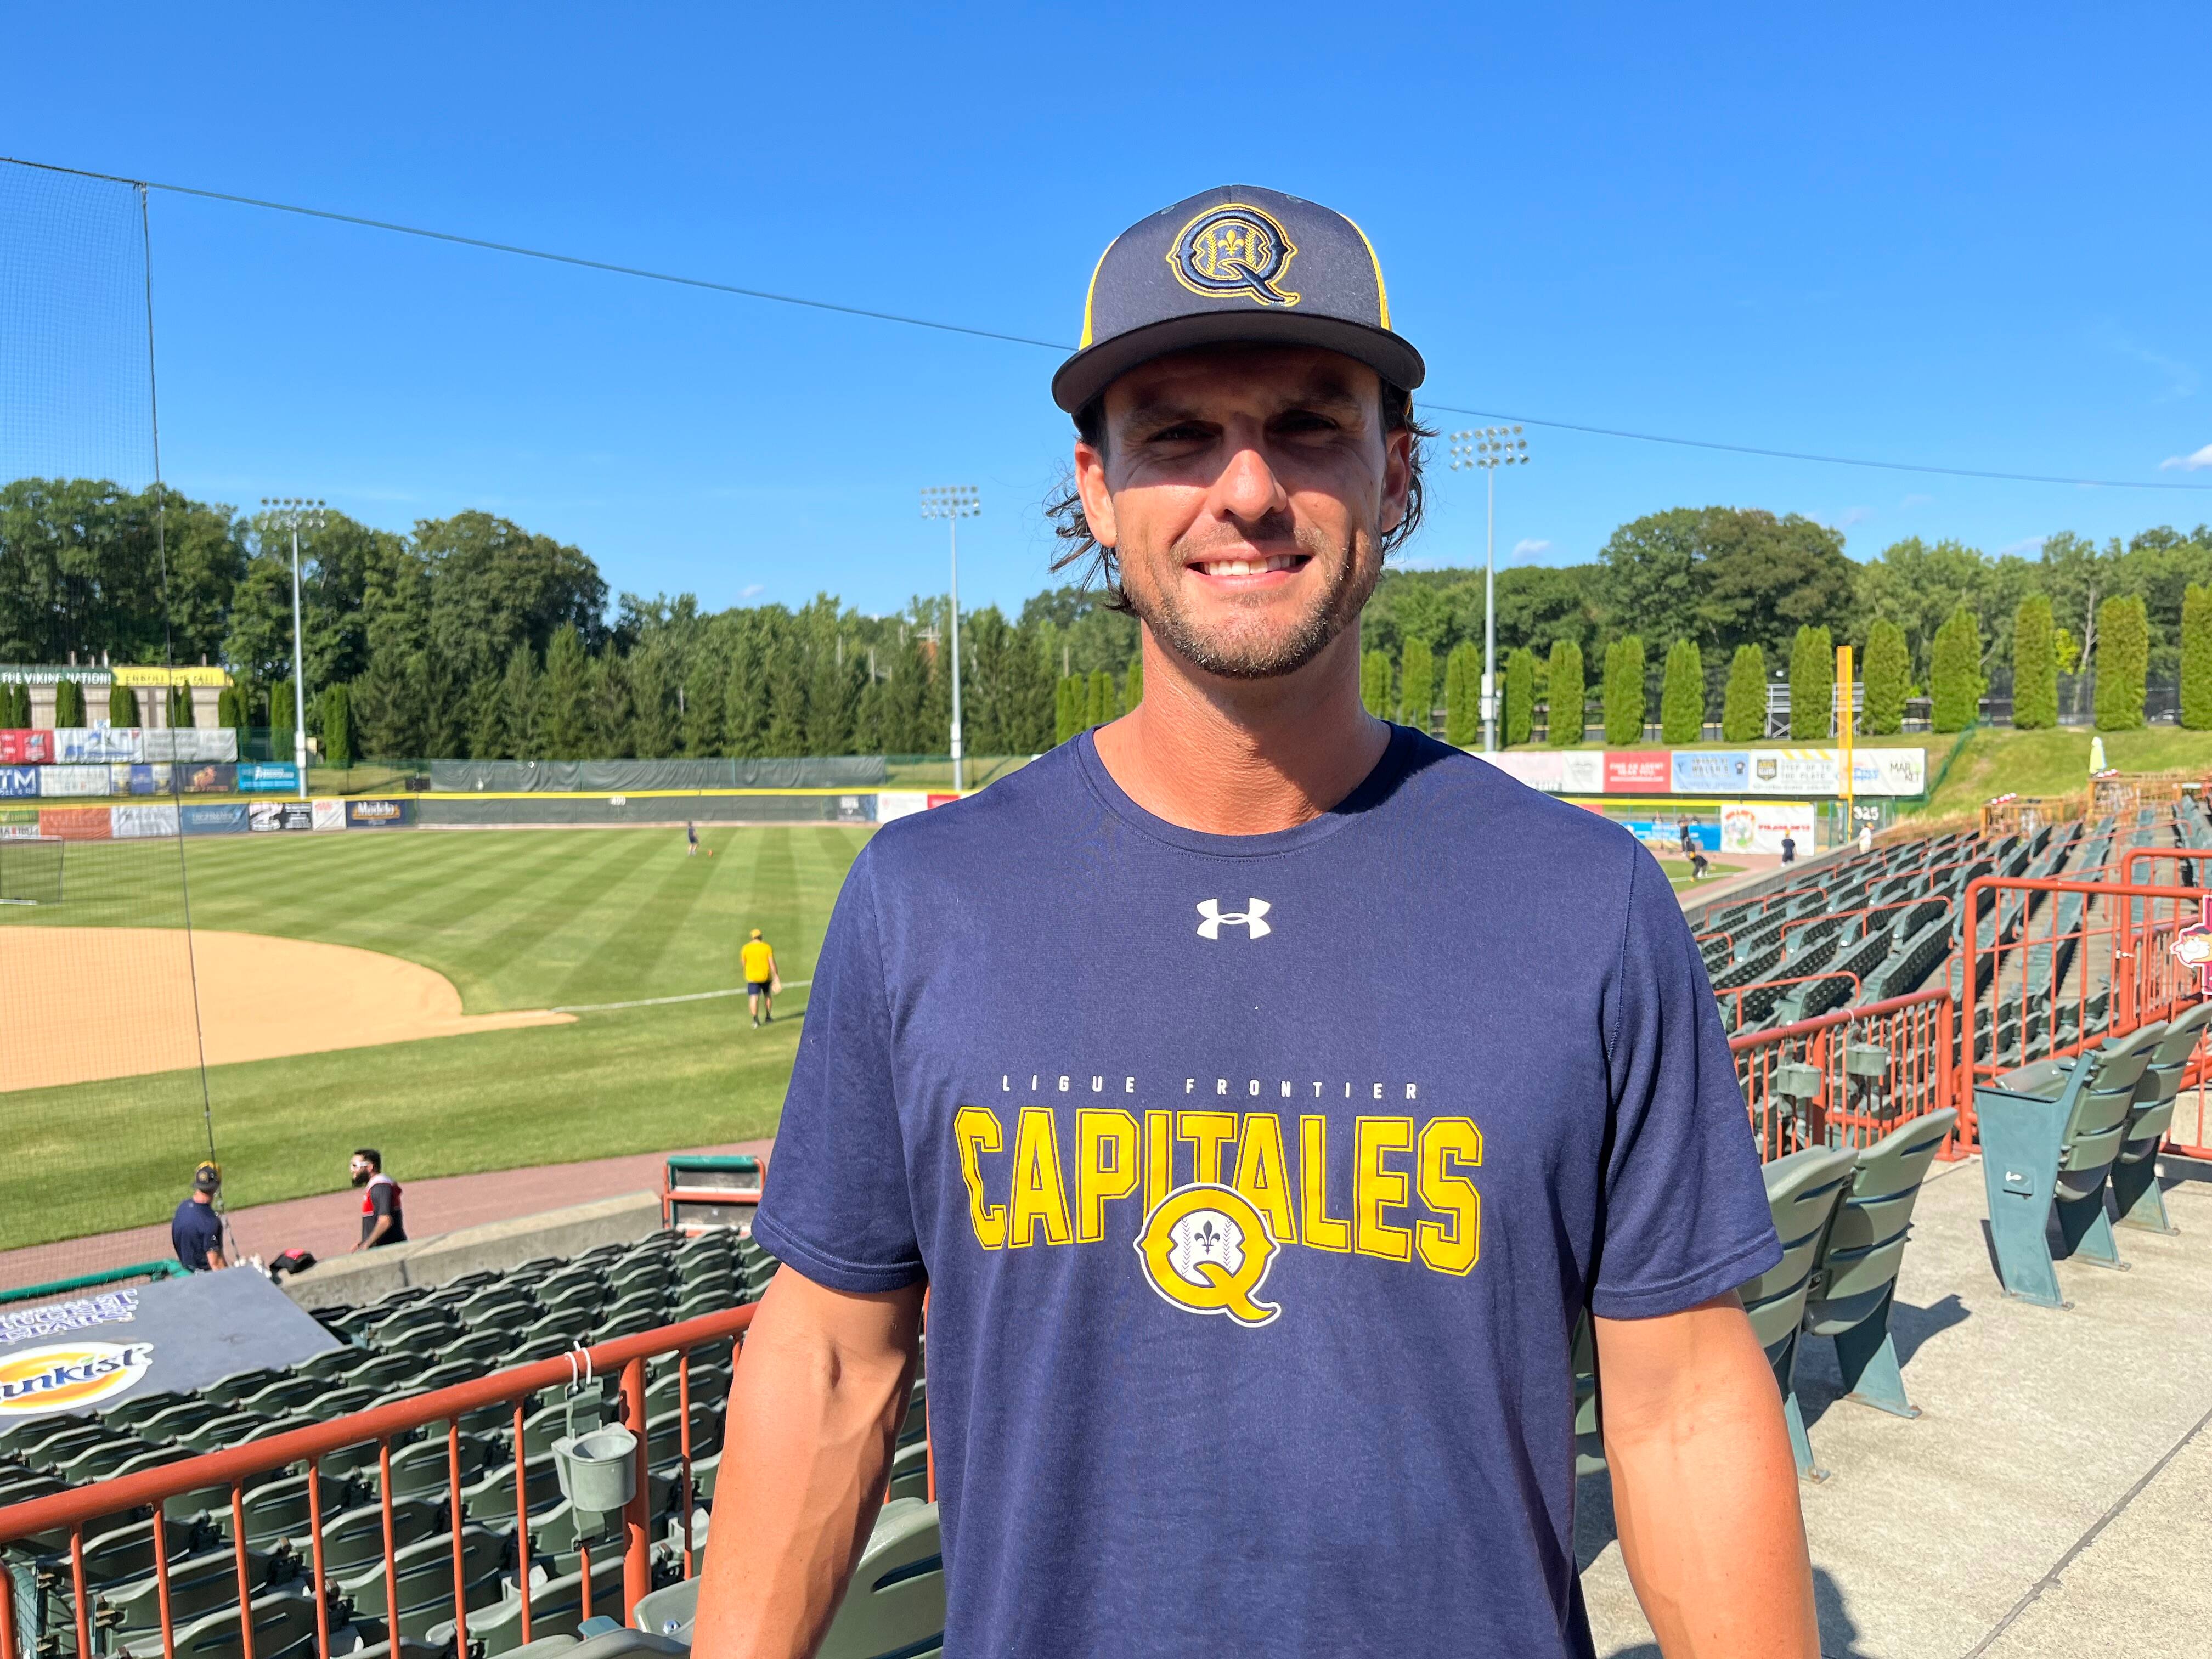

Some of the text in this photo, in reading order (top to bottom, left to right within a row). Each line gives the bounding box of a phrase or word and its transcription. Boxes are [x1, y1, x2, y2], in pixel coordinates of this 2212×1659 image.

[1, 672, 22, 684] THE
[24, 672, 64, 684] VIKING
[357, 801, 396, 817] Modelo
[1853, 806, 1879, 821] 325
[1002, 1075, 1419, 1099] LIGUE FRONTIER
[953, 1105, 1483, 1277] CAPITALES
[1133, 1182, 1281, 1328] Q
